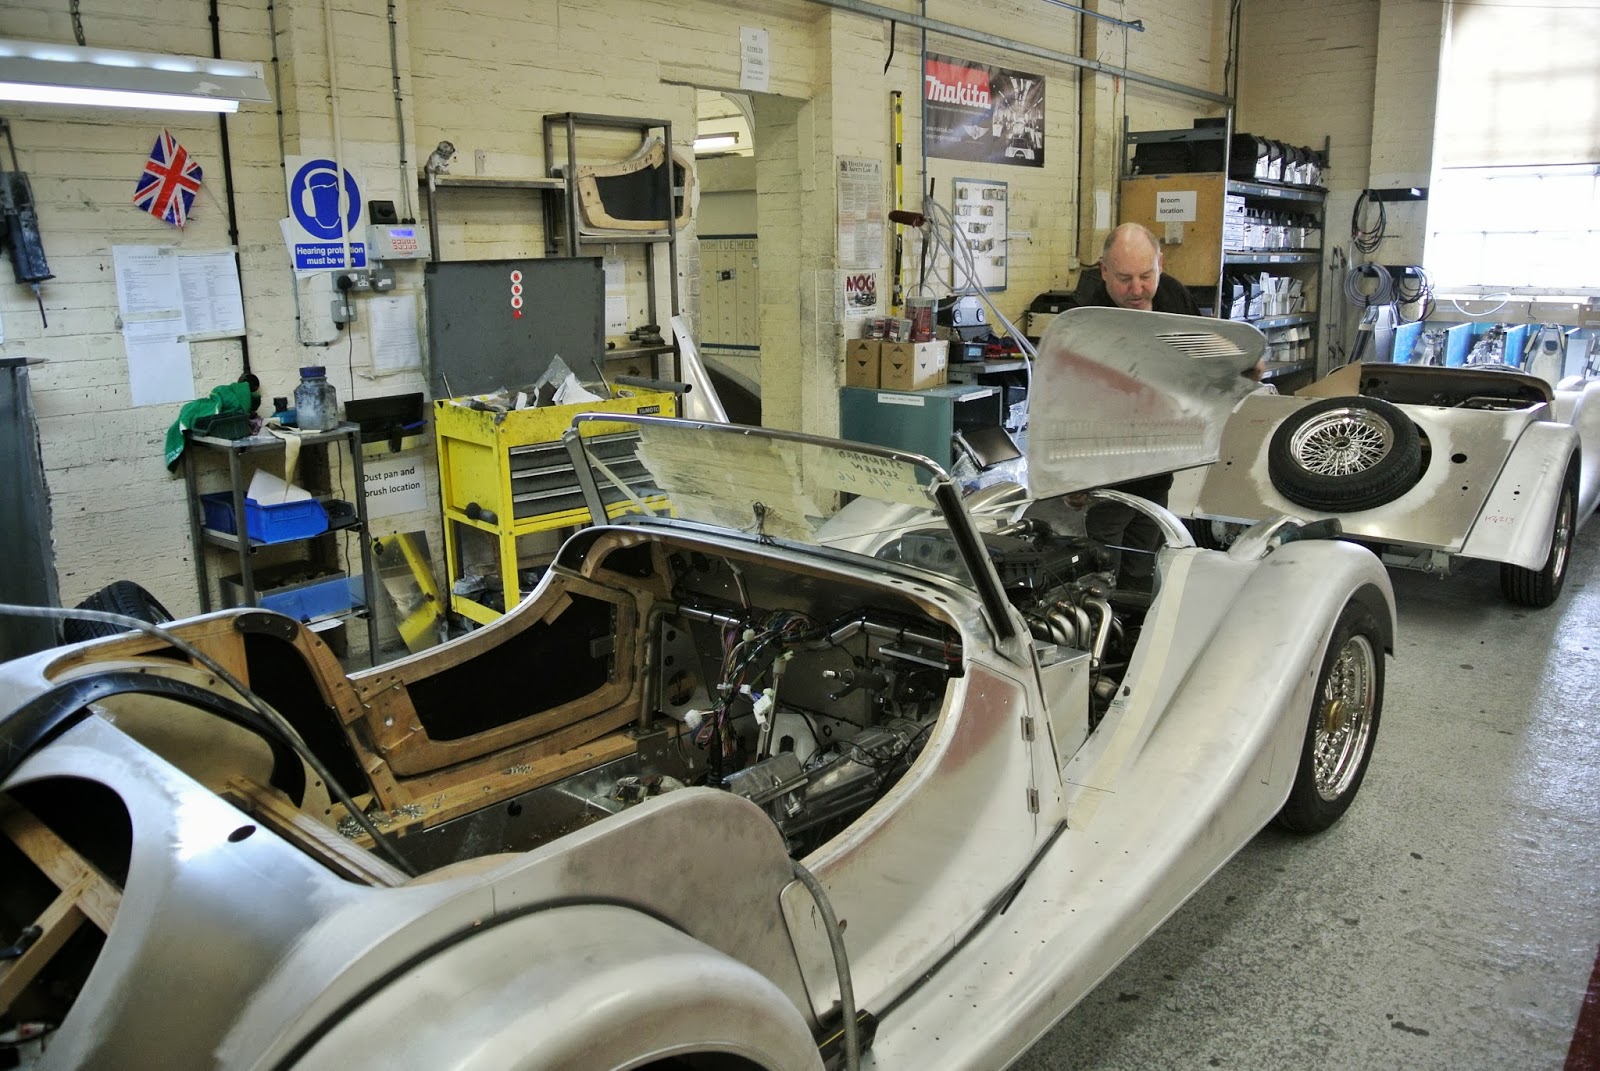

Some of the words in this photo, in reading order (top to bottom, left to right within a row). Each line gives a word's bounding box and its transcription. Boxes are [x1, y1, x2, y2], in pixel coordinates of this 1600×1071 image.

[925, 75, 991, 109] Makita
[719, 240, 735, 250] TUE
[736, 240, 754, 250] WED
[297, 247, 326, 256] Hearing
[327, 247, 364, 256] prottion
[307, 257, 325, 265] must
[326, 256, 337, 264] be
[639, 406, 660, 414] YAMOTO
[363, 473, 382, 482] Dust
[384, 471, 398, 480] pan
[400, 466, 415, 476] and
[389, 482, 421, 493] location
